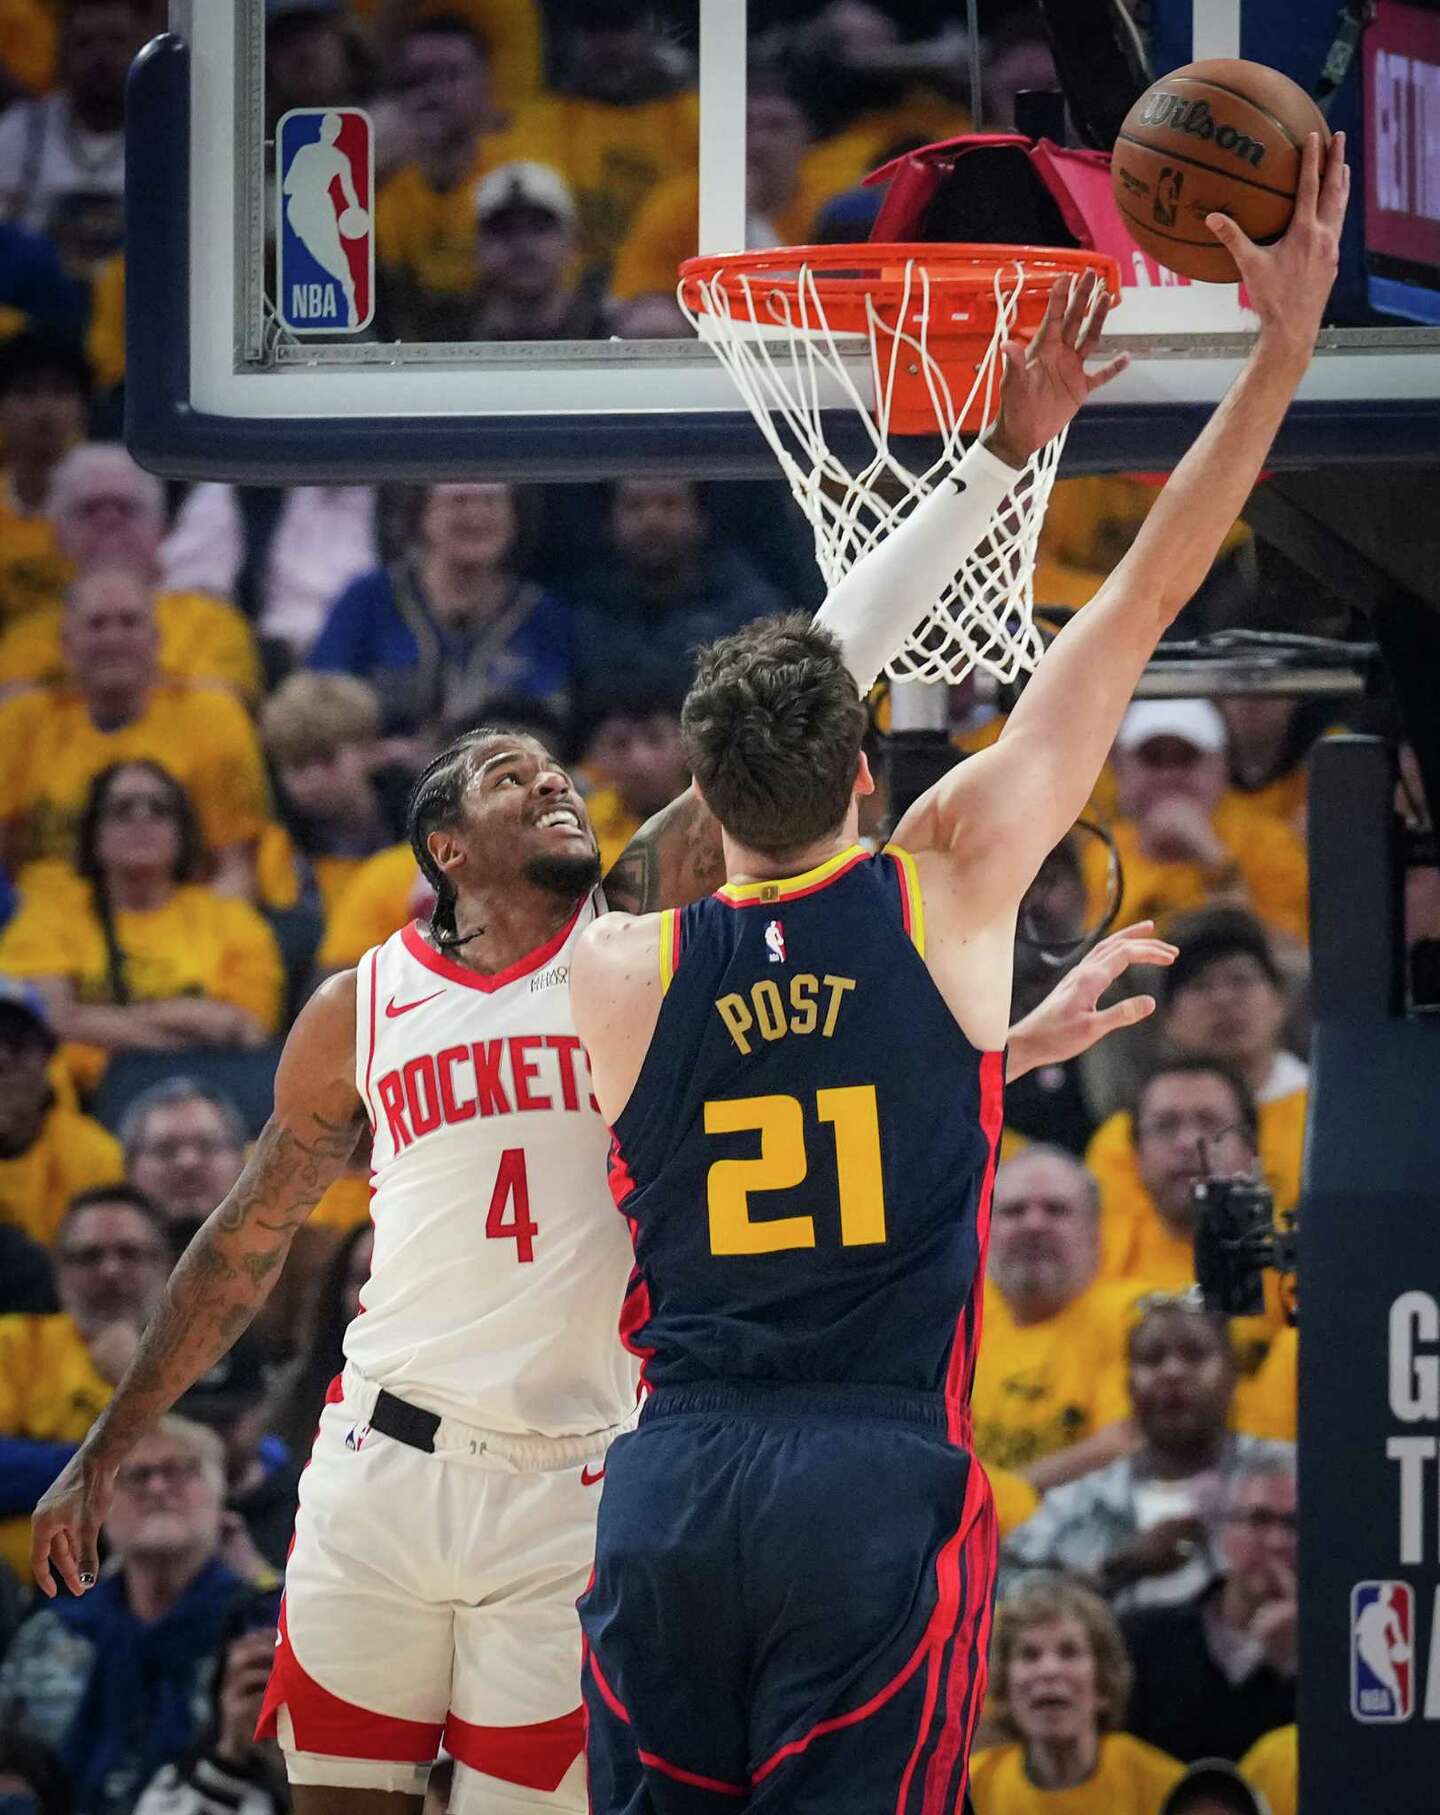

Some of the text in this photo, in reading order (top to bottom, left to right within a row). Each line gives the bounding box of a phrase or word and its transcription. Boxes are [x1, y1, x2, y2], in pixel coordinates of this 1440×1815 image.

[1139, 92, 1265, 169] Wilson
[292, 283, 337, 318] NBA
[715, 973, 856, 1055] POST
[485, 1148, 538, 1263] 4
[704, 1084, 886, 1256] 21
